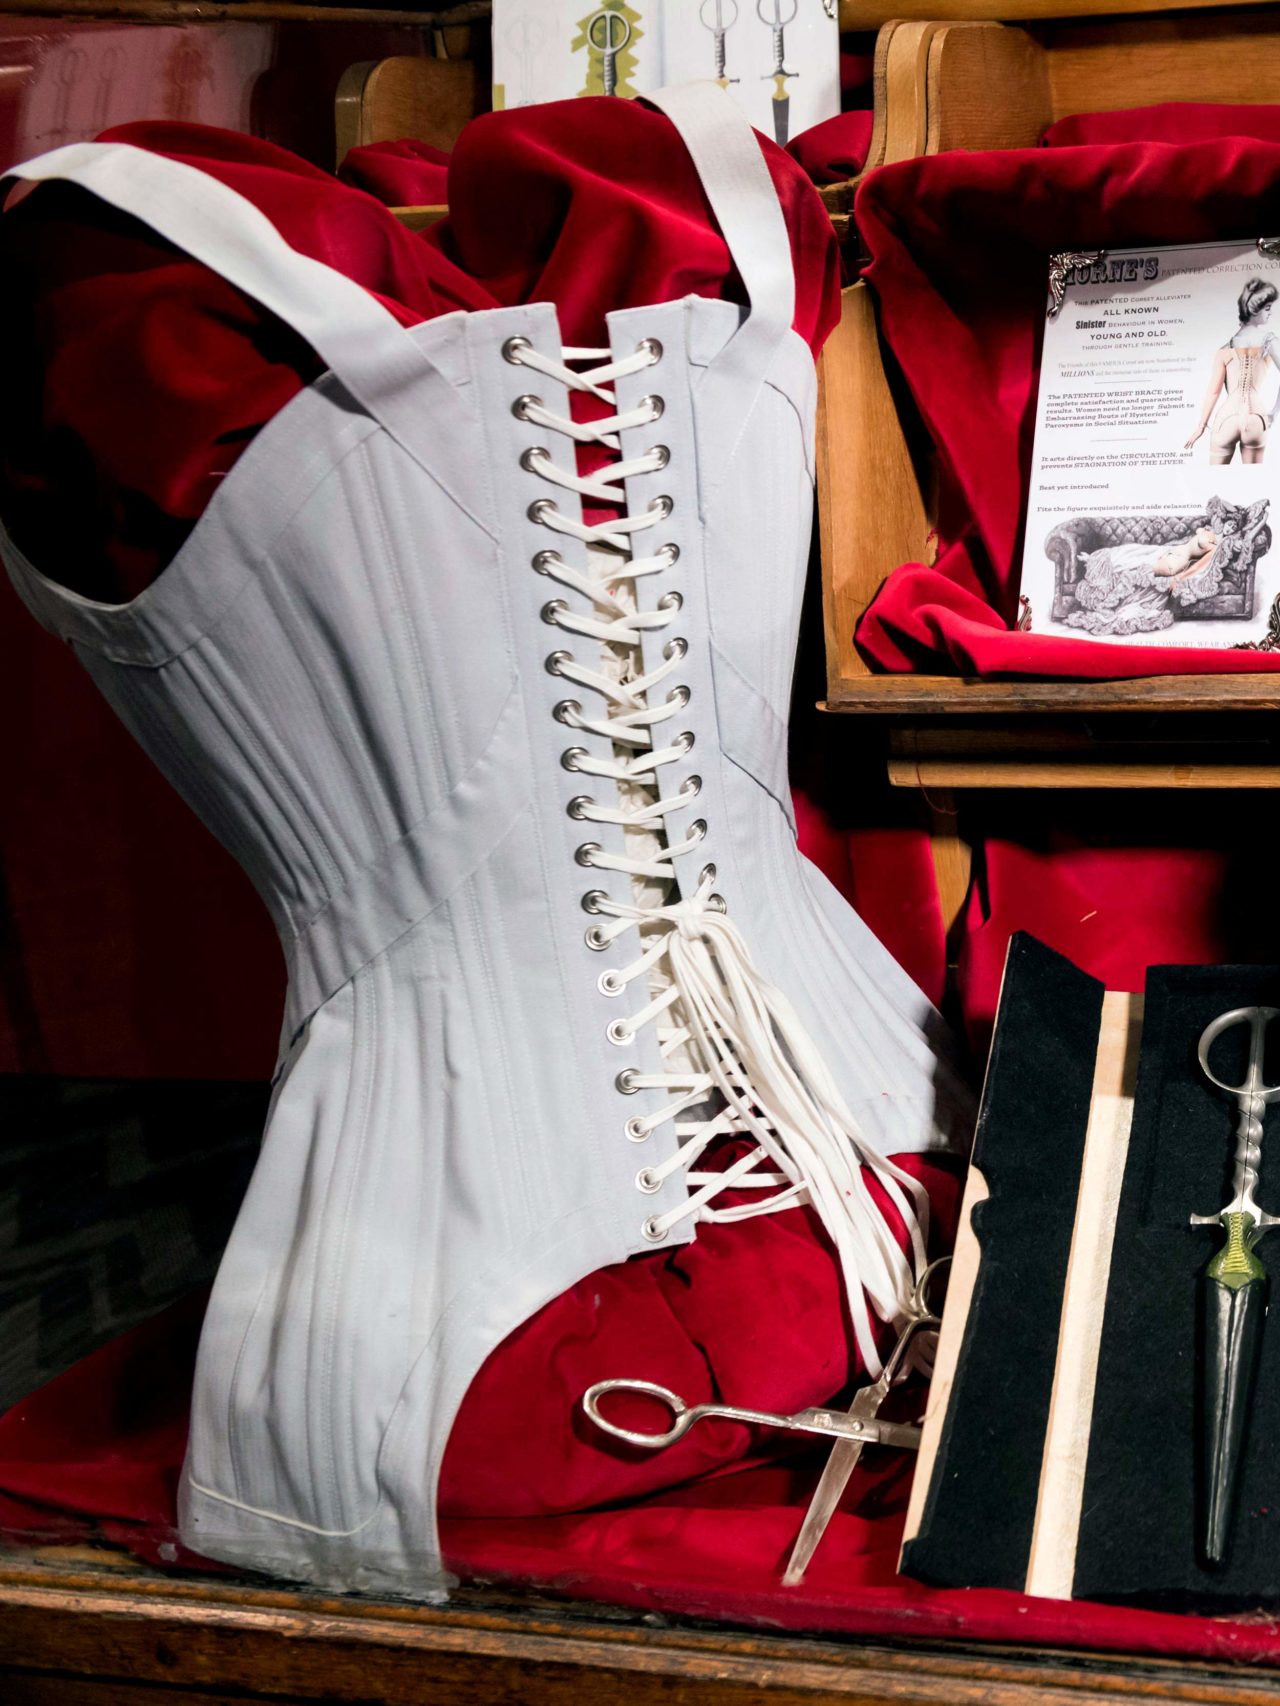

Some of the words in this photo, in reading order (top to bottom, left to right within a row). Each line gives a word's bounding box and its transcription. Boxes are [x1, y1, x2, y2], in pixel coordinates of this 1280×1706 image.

[1161, 266, 1205, 277] PATENTED
[1206, 262, 1263, 274] CORRECTION
[1090, 297, 1129, 305] PATENTED
[1124, 306, 1159, 315] KNOWN
[1075, 320, 1106, 330] Sinister
[1090, 332, 1122, 340] YOUNG
[1124, 331, 1145, 339] AND
[1140, 396, 1183, 404] guaranteed
[1066, 505, 1089, 513] figure
[1089, 504, 1130, 512] exquisitely
